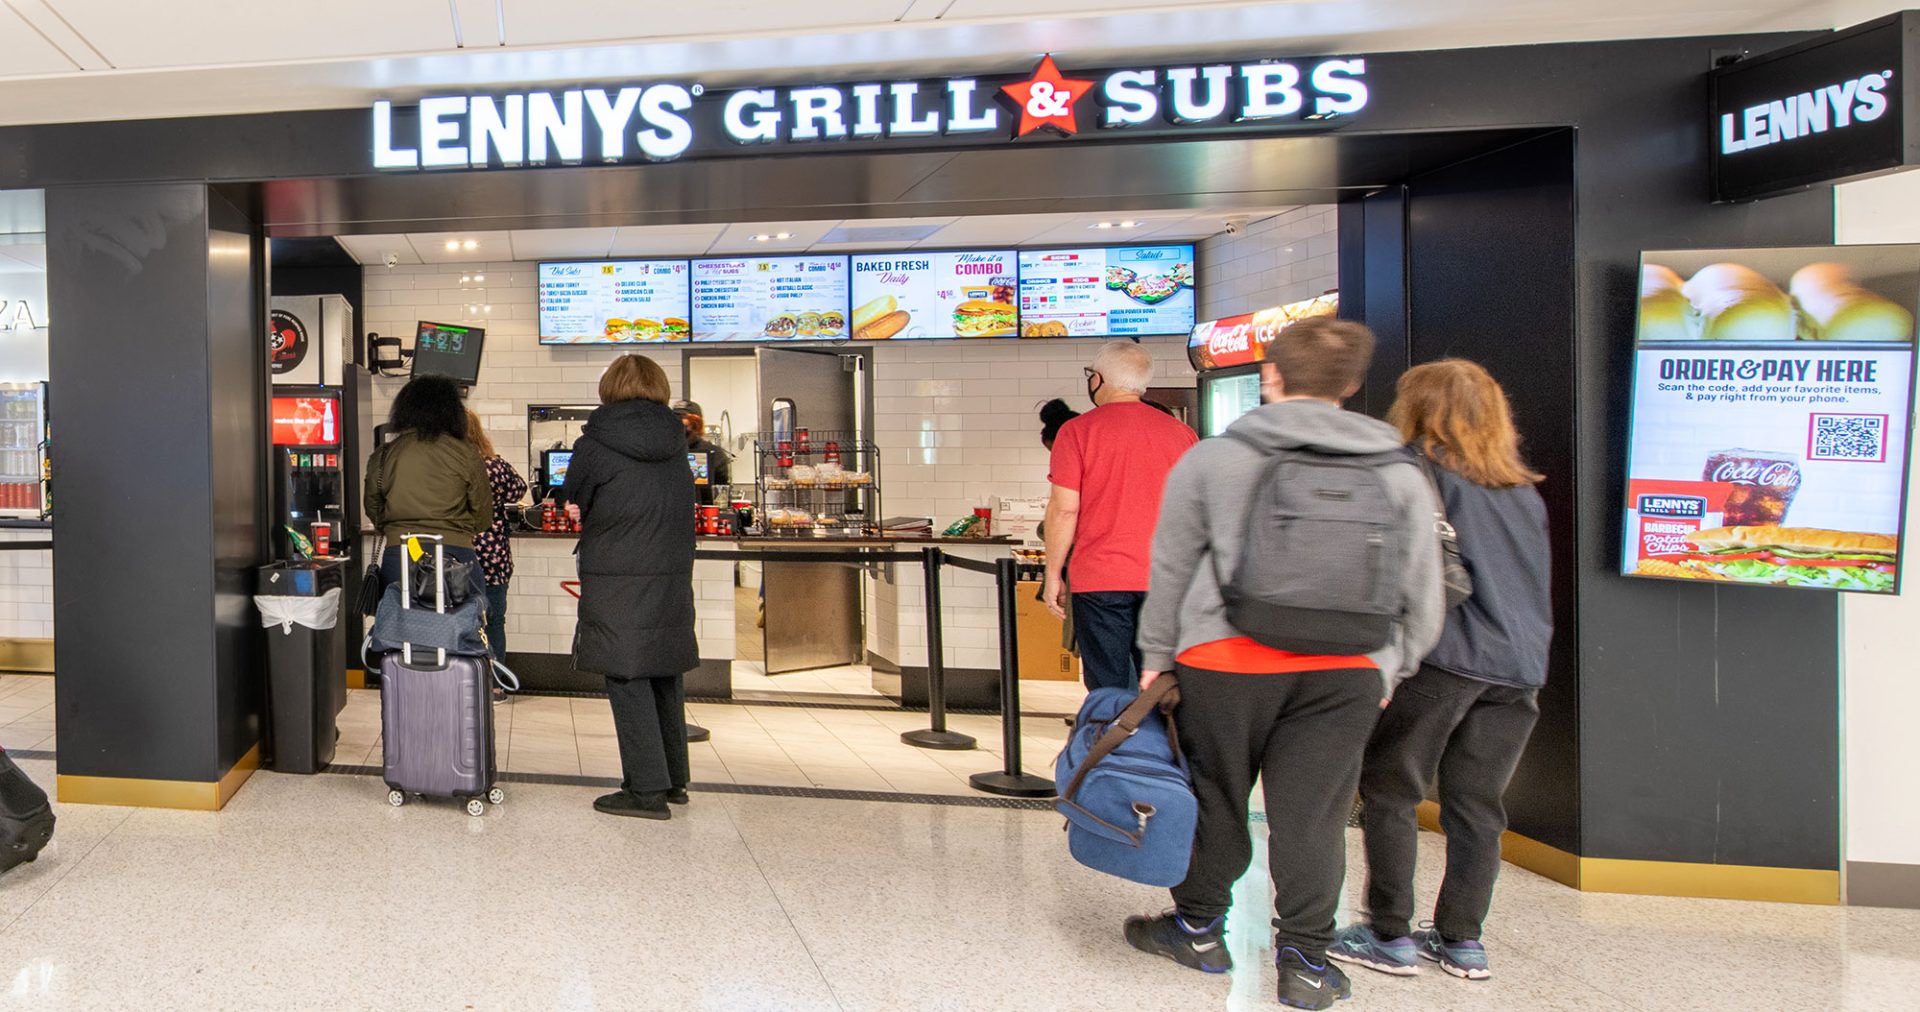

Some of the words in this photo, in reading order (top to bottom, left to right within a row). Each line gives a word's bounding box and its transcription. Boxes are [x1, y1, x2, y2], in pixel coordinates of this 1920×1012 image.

[723, 80, 998, 140] GRILL
[1026, 81, 1070, 117] &
[1104, 59, 1368, 123] SUBS
[856, 262, 891, 272] BAKED
[895, 260, 929, 270] FRESH
[955, 263, 1003, 275] COMBO
[876, 272, 909, 284] Daily
[1255, 326, 1275, 343] ICE
[1816, 360, 1877, 382] HERE
[1658, 383, 1684, 392] Scan
[1688, 383, 1705, 392] the
[1708, 384, 1738, 393] code,
[1742, 384, 1762, 393] add
[1766, 386, 1791, 394] your
[1795, 385, 1841, 394] favorite
[1844, 386, 1881, 395] items,
[1697, 393, 1716, 402] pay
[1720, 393, 1746, 402] right
[1750, 393, 1776, 401] from
[1780, 395, 1805, 403] your
[1809, 395, 1849, 404] phone.
[1644, 522, 1697, 535] BARBECUE
[1643, 534, 1687, 544] Potat
[1646, 542, 1690, 553] Chips
